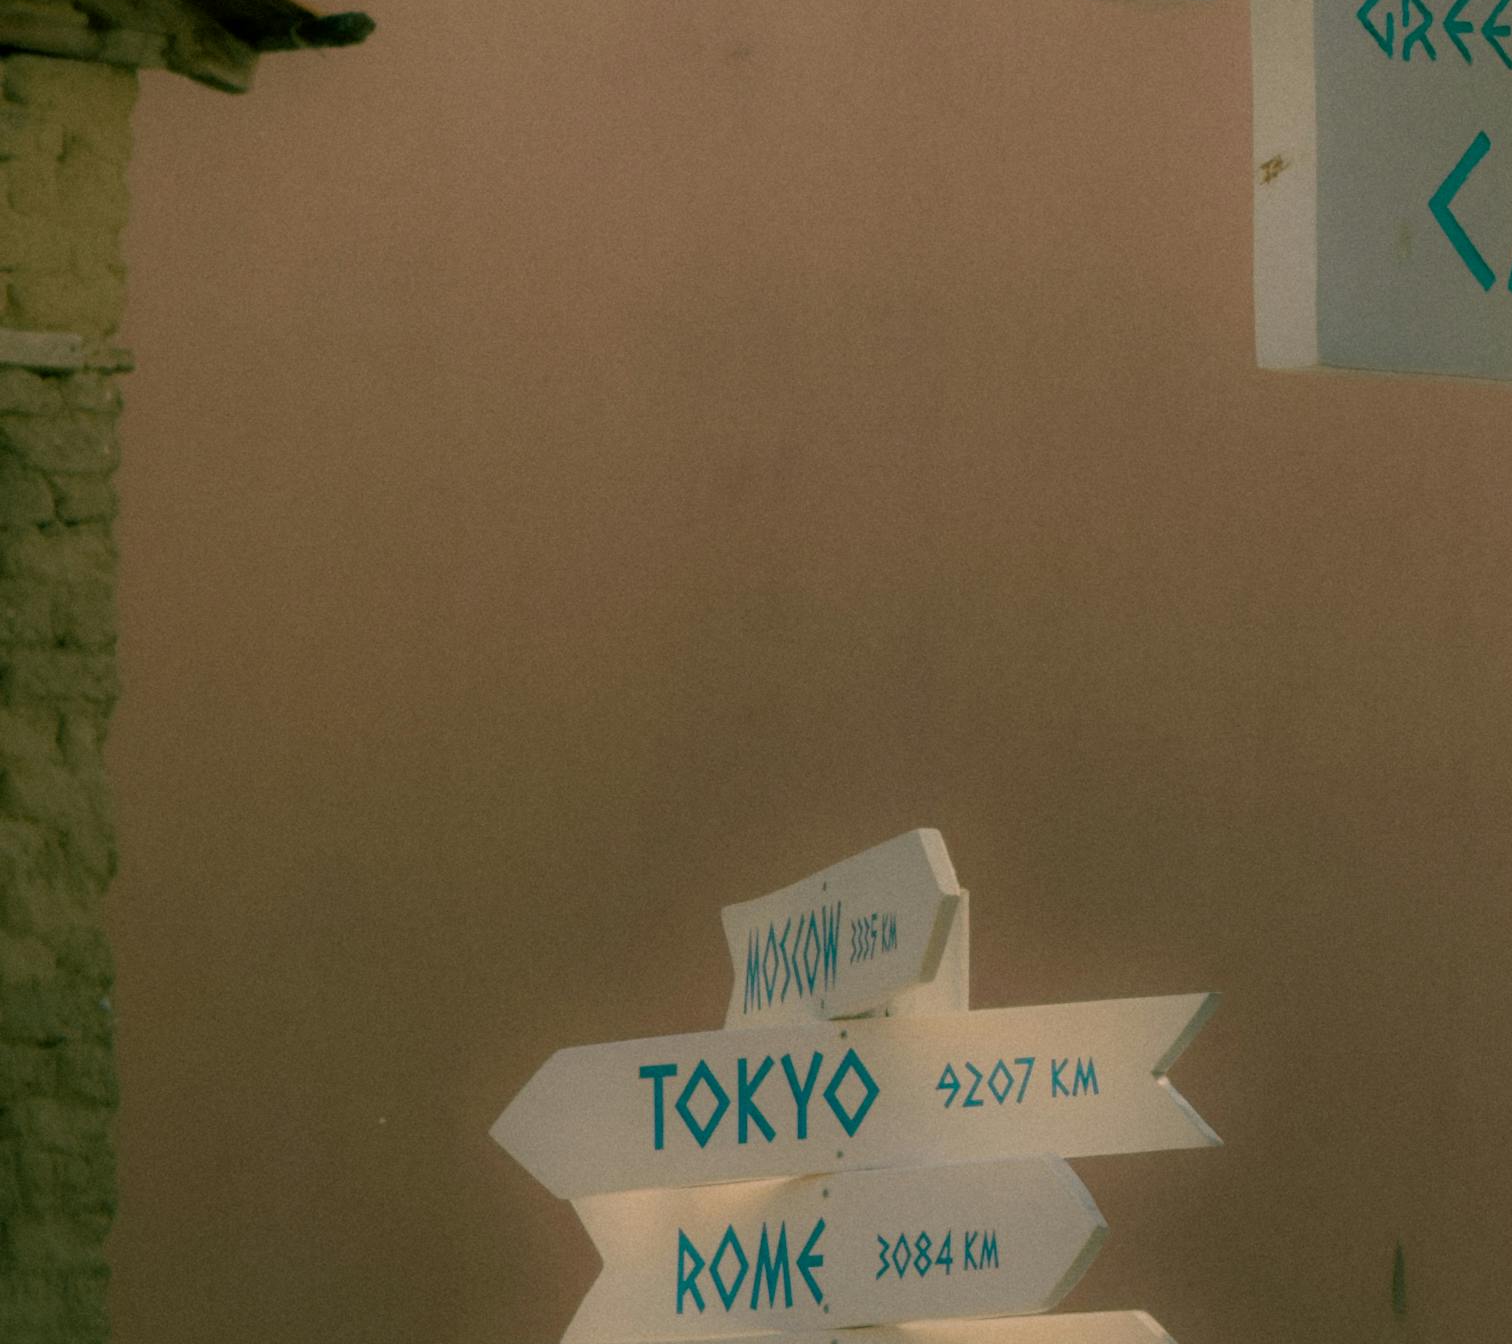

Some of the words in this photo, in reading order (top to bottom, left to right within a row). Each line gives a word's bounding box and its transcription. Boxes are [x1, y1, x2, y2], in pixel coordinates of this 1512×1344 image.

[743, 900, 842, 1015] MOSCOW
[881, 912, 898, 953] KM
[639, 1048, 880, 1150] TOKYO
[936, 1056, 1036, 1111] 9207
[1051, 1057, 1100, 1098] KM
[676, 1217, 826, 1314] ROME
[877, 1232, 953, 1278] 3084
[964, 1229, 1000, 1271] KM
